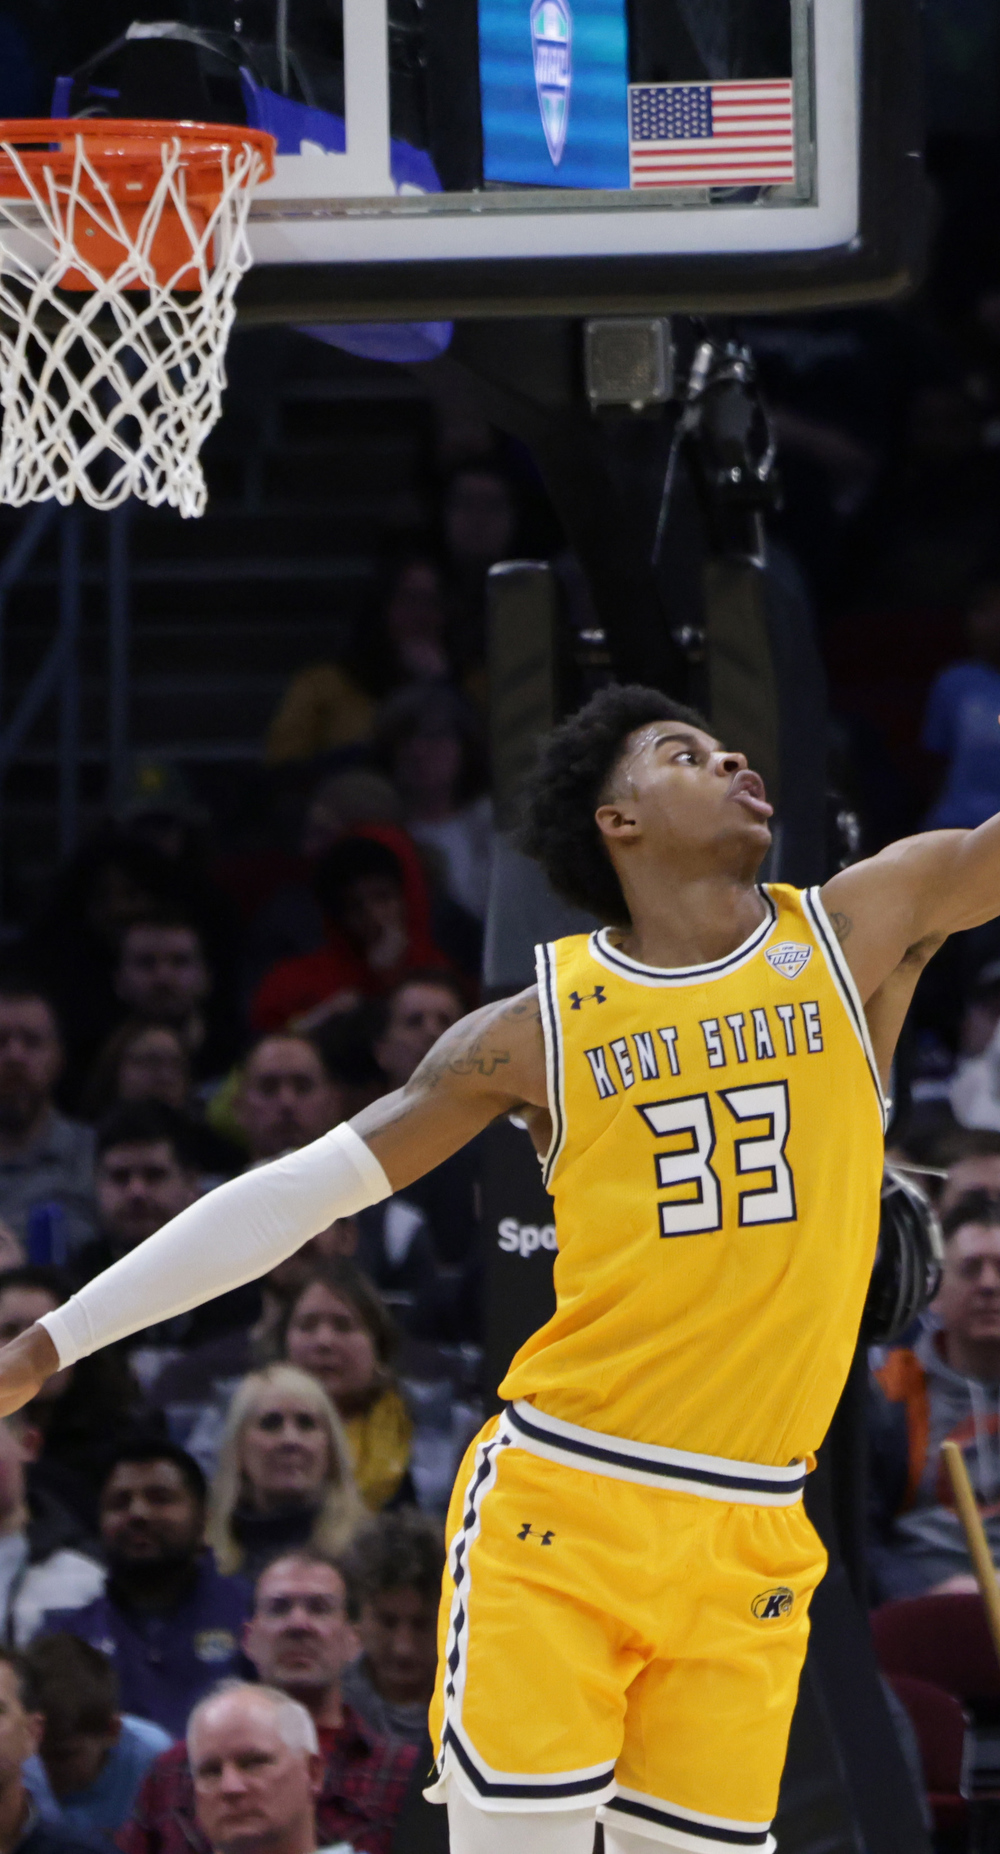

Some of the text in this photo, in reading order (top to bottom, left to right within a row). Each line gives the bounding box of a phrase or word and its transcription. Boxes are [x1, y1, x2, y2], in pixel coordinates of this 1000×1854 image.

[584, 1001, 824, 1100] KENT STATE
[634, 1079, 798, 1239] 33
